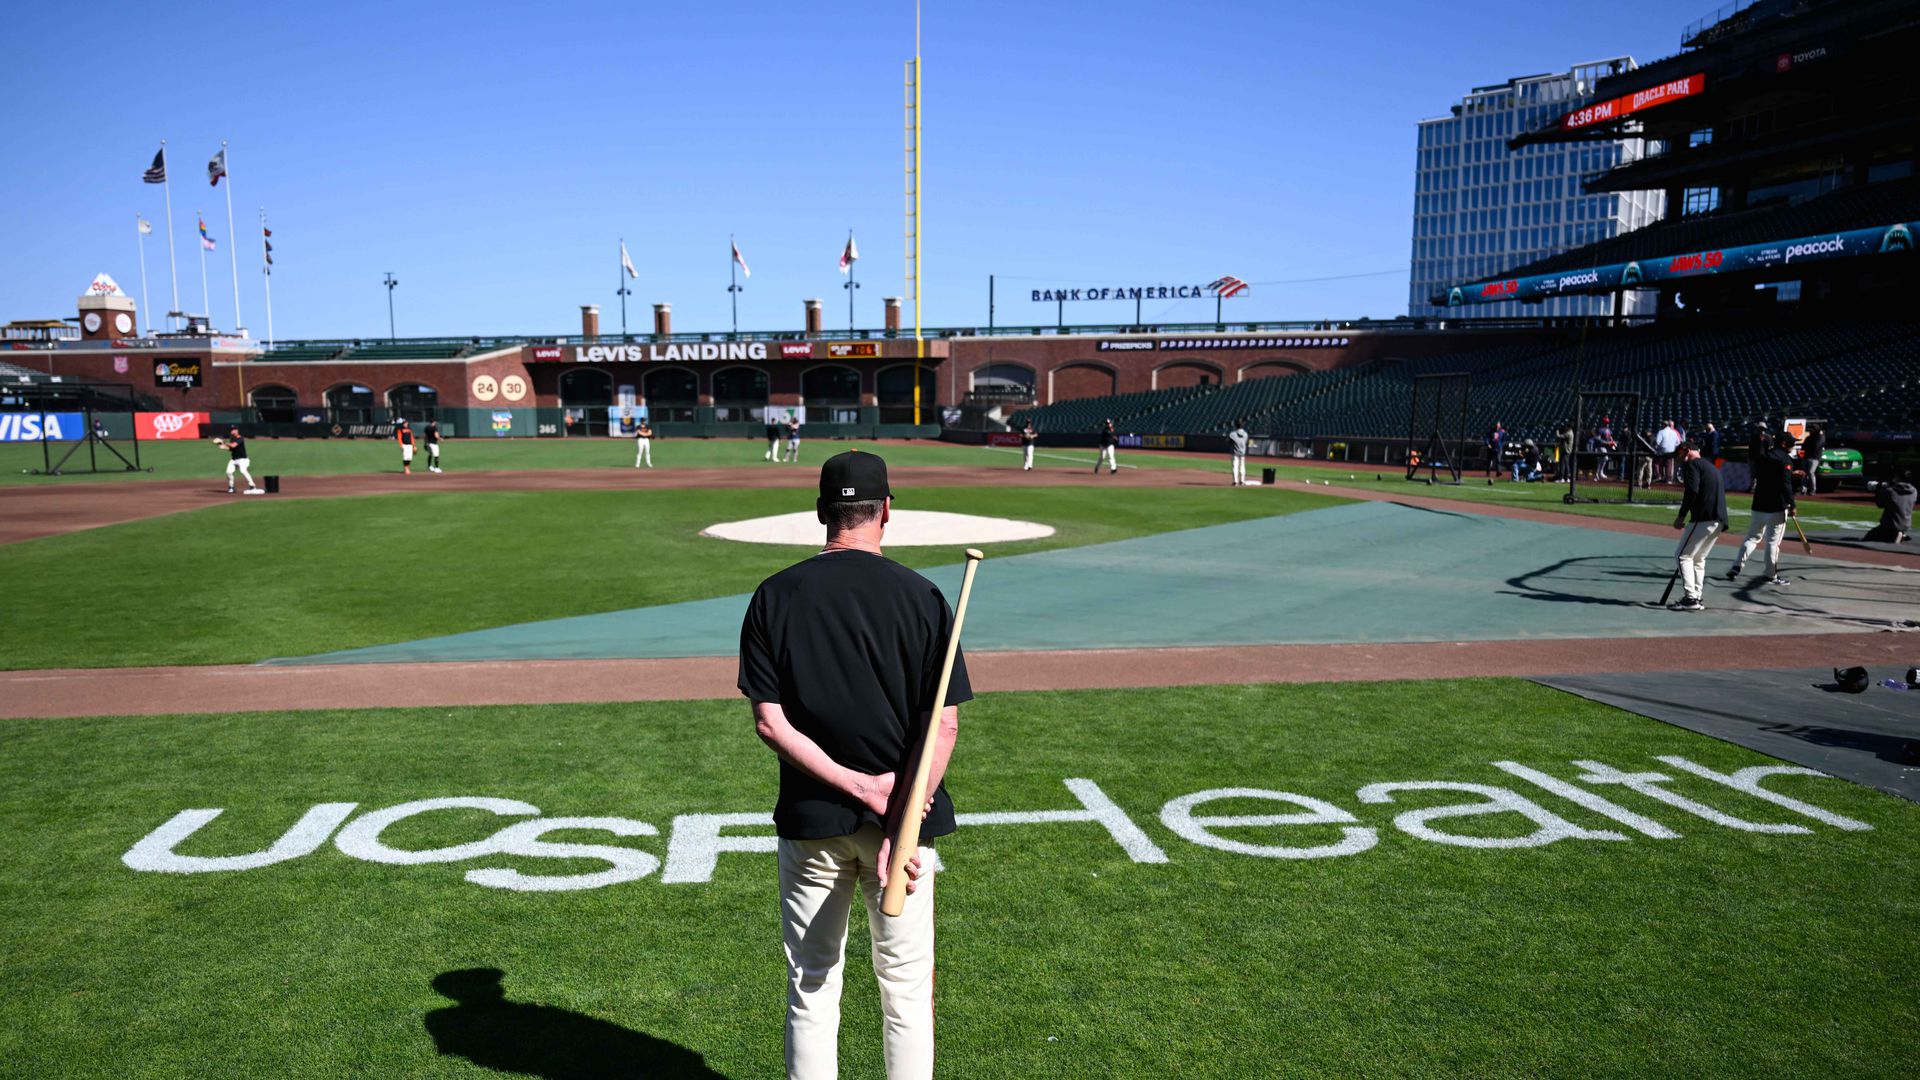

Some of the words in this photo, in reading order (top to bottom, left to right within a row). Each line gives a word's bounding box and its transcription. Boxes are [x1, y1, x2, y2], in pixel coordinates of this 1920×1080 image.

[1793, 48, 1826, 63] TOYOTA
[1633, 86, 1665, 108] ORACLE
[1667, 79, 1690, 95] PARK
[1567, 111, 1593, 128] 4:36
[1595, 104, 1612, 120] PM
[1785, 235, 1844, 263] peacock
[1669, 253, 1702, 272] JAWS
[1704, 251, 1722, 268] 50
[1481, 281, 1504, 297] JAWS
[1506, 280, 1518, 294] 50
[1559, 270, 1598, 292] peacock
[1031, 289, 1080, 301] BANK
[1087, 288, 1110, 300] OF
[1115, 286, 1202, 299] AMERICA
[650, 343, 767, 361] LANDING
[1110, 342, 1153, 350] PRIZEPICKS
[162, 375, 175, 383] BAY
[176, 374, 193, 382] AREA
[478, 383, 493, 394] 24
[506, 383, 522, 394] 30
[0, 414, 63, 440] VISA
[349, 424, 374, 434] TRIPLES
[539, 425, 556, 433] 365
